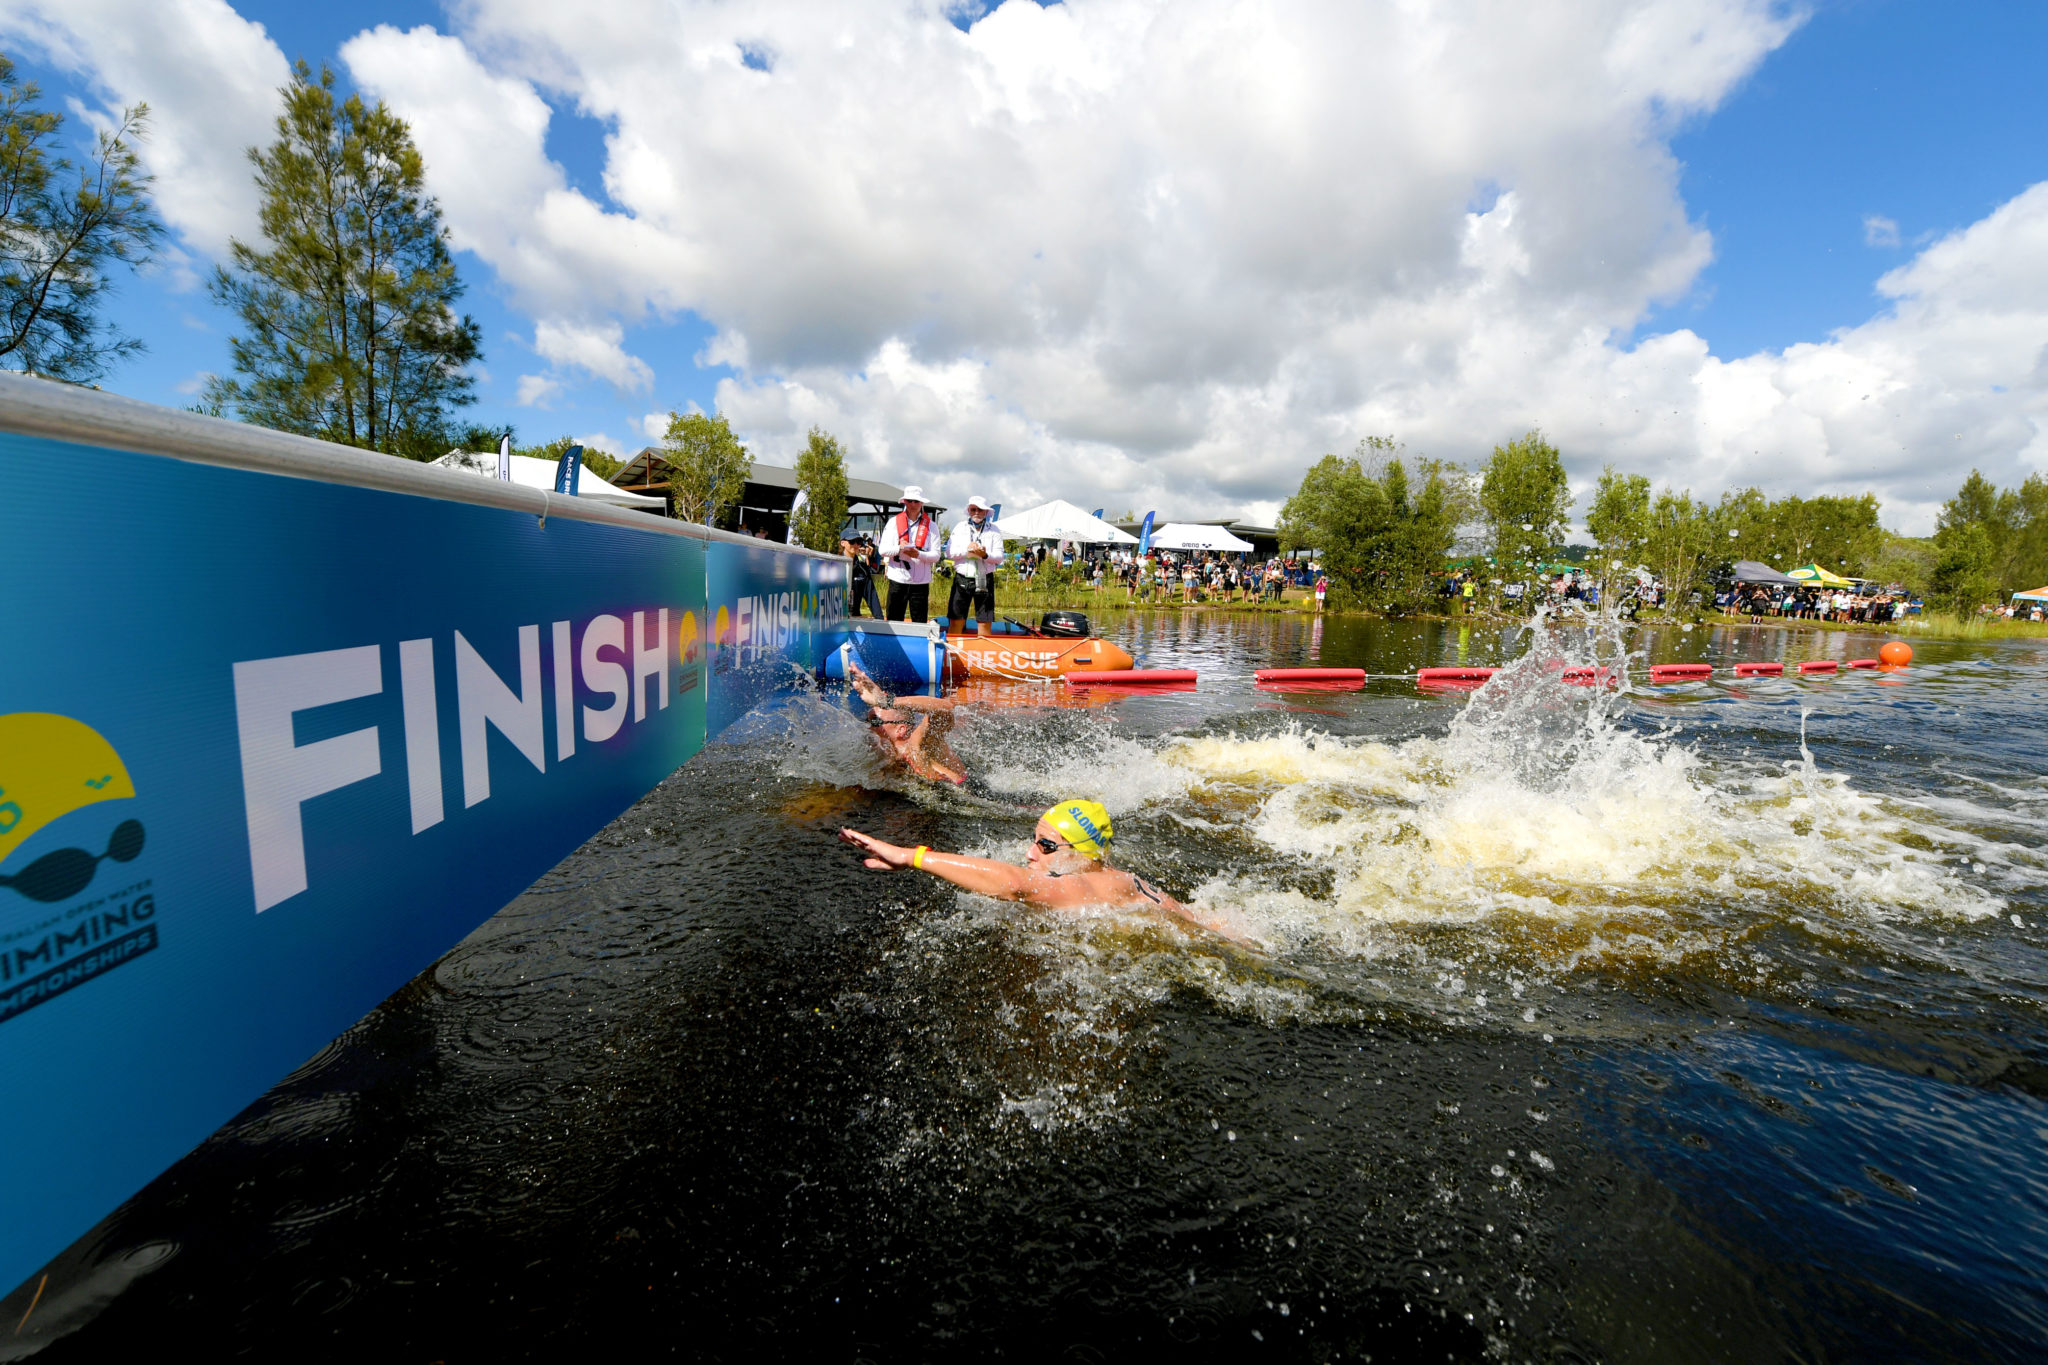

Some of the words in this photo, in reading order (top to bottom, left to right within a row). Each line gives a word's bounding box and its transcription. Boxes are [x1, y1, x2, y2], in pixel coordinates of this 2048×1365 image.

[735, 591, 800, 670] FINISH
[819, 586, 844, 632] FINISH
[967, 649, 1059, 671] RESCUE
[232, 607, 669, 915] FINISH
[0, 893, 155, 981] IMMING
